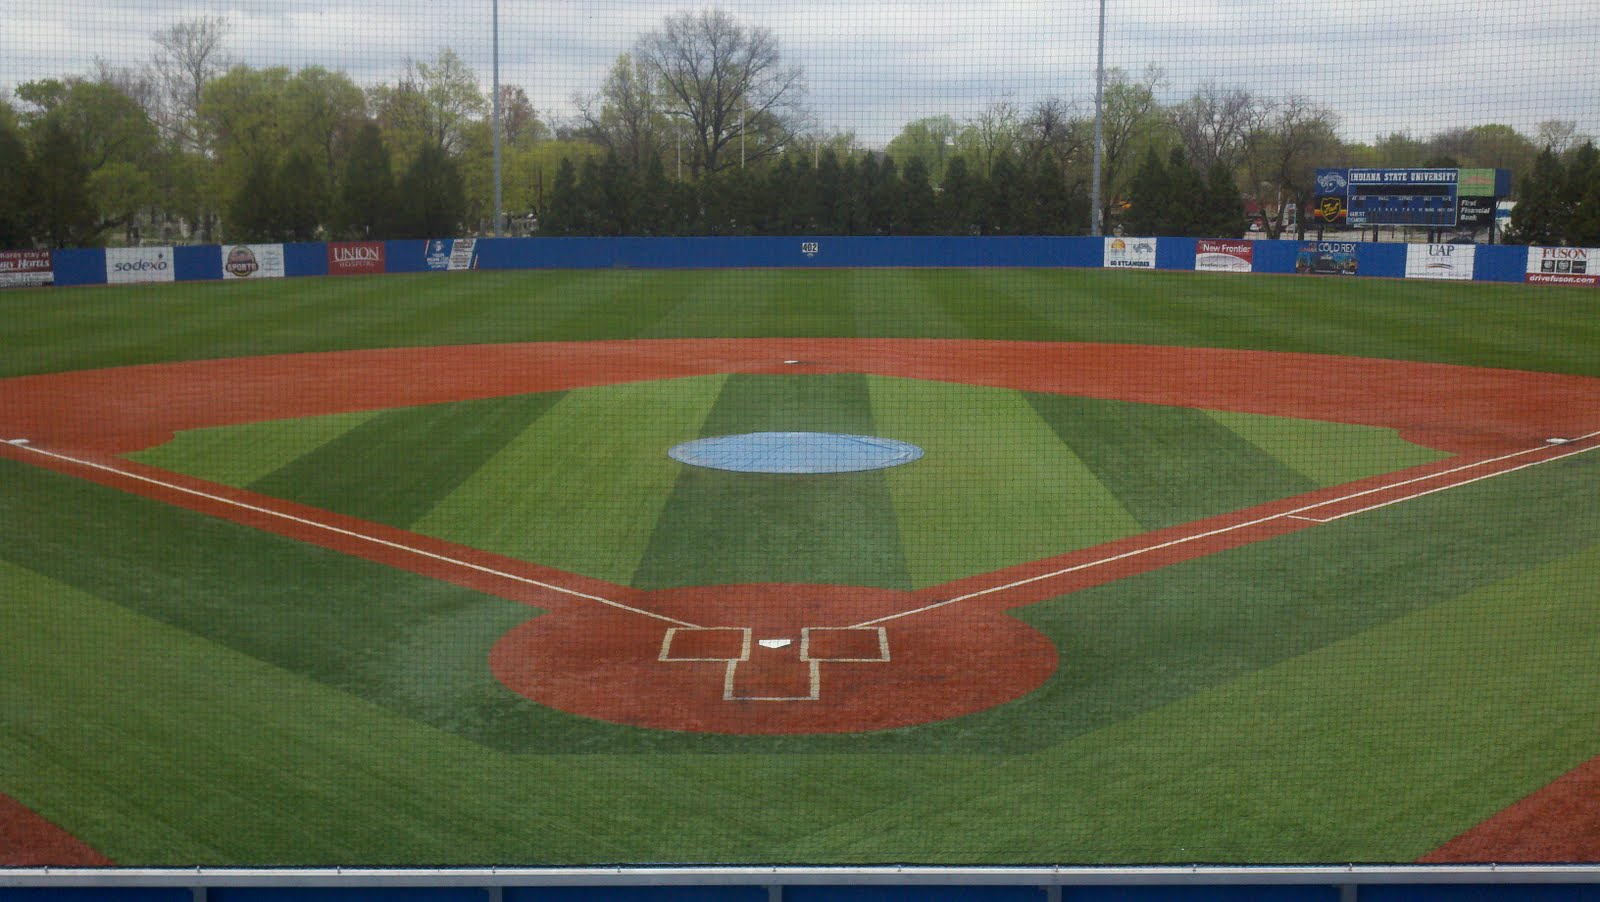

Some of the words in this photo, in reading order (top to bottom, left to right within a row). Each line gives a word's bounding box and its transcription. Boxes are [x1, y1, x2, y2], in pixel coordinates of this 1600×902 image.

[1350, 172, 1381, 181] INDIANA
[1384, 172, 1408, 181] STATE
[1411, 172, 1457, 181] UNIVERSITY
[803, 243, 817, 252] 402
[1203, 244, 1219, 252] New
[1222, 244, 1251, 253] Frontier
[1318, 242, 1340, 253] COLD
[1341, 243, 1356, 253] REX
[1429, 244, 1455, 256] UAP
[333, 246, 380, 261] UNION
[1542, 248, 1587, 259] FUSON
[114, 259, 167, 272] sodexo
[227, 263, 257, 272] SPORTS
[1529, 275, 1595, 284] drivefuson.com
